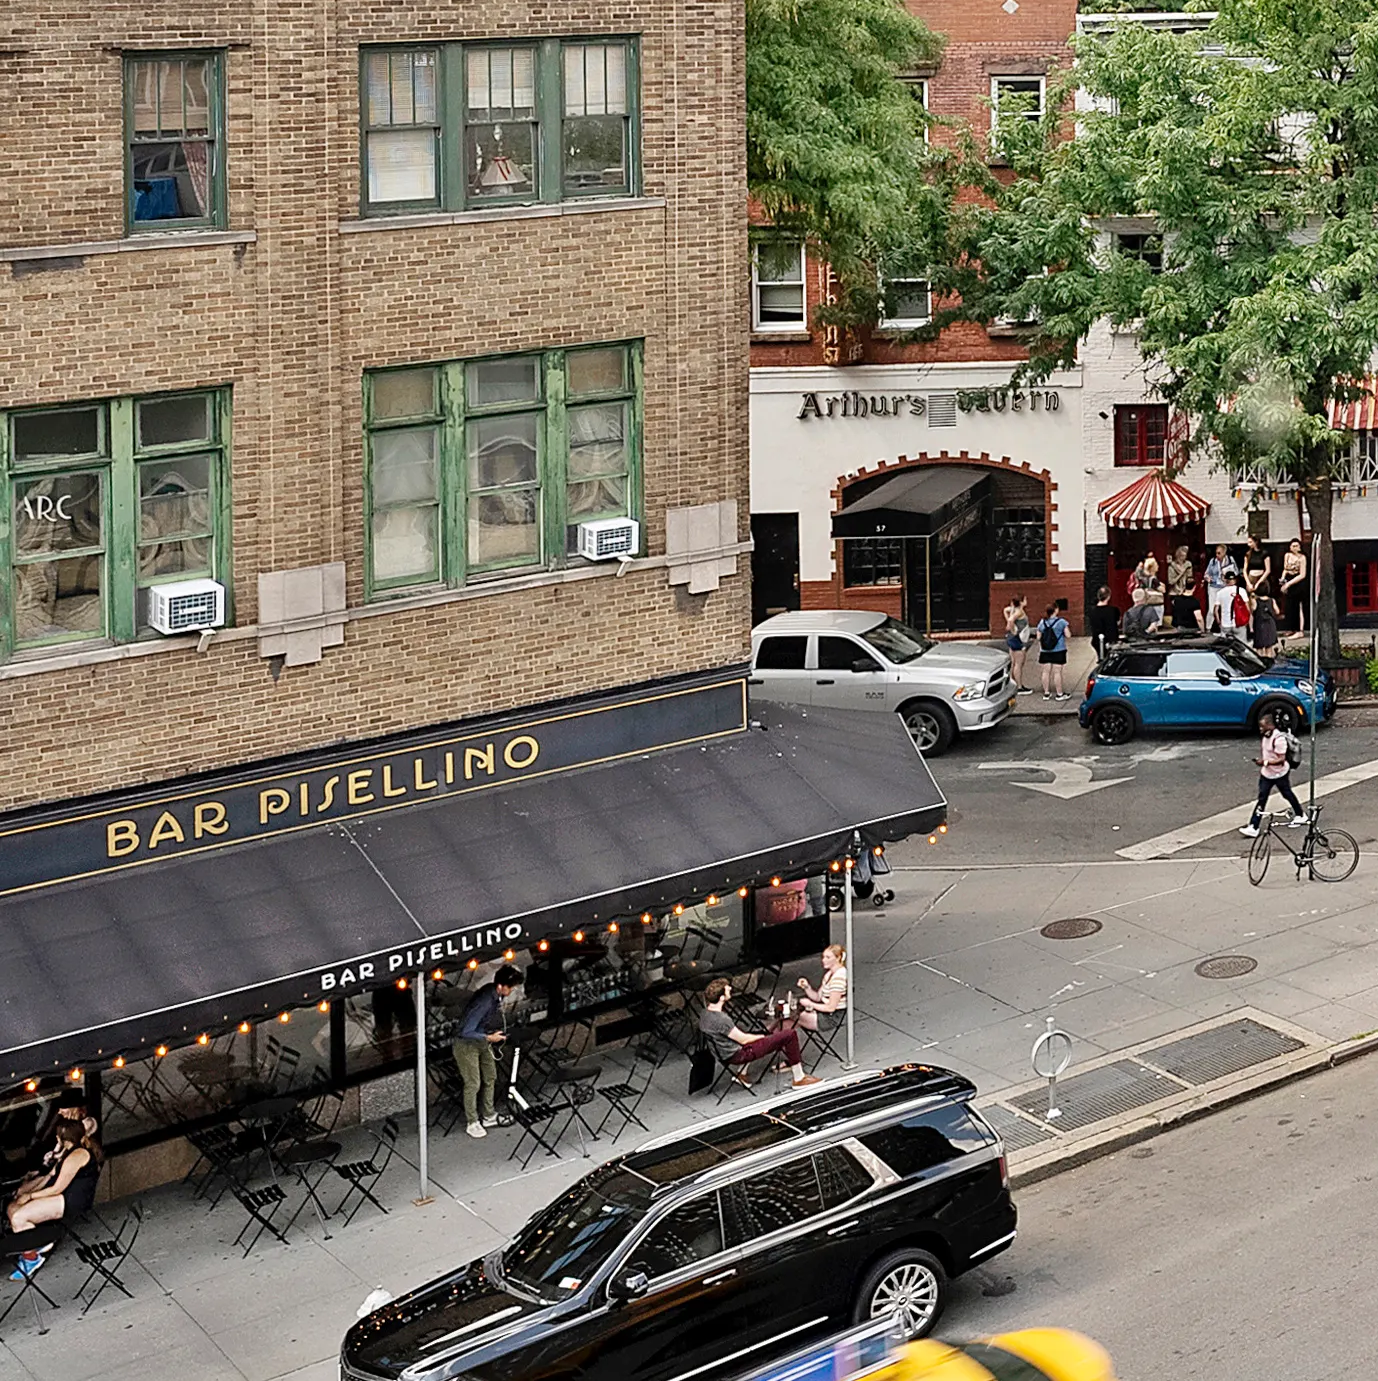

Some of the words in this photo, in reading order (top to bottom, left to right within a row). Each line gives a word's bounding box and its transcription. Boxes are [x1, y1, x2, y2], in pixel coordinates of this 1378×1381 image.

[797, 390, 927, 420] Arthur's
[106, 801, 230, 858] BAR
[258, 734, 540, 825] PISELLINO
[320, 962, 376, 991] BAR
[388, 922, 523, 973] PISELLINO
